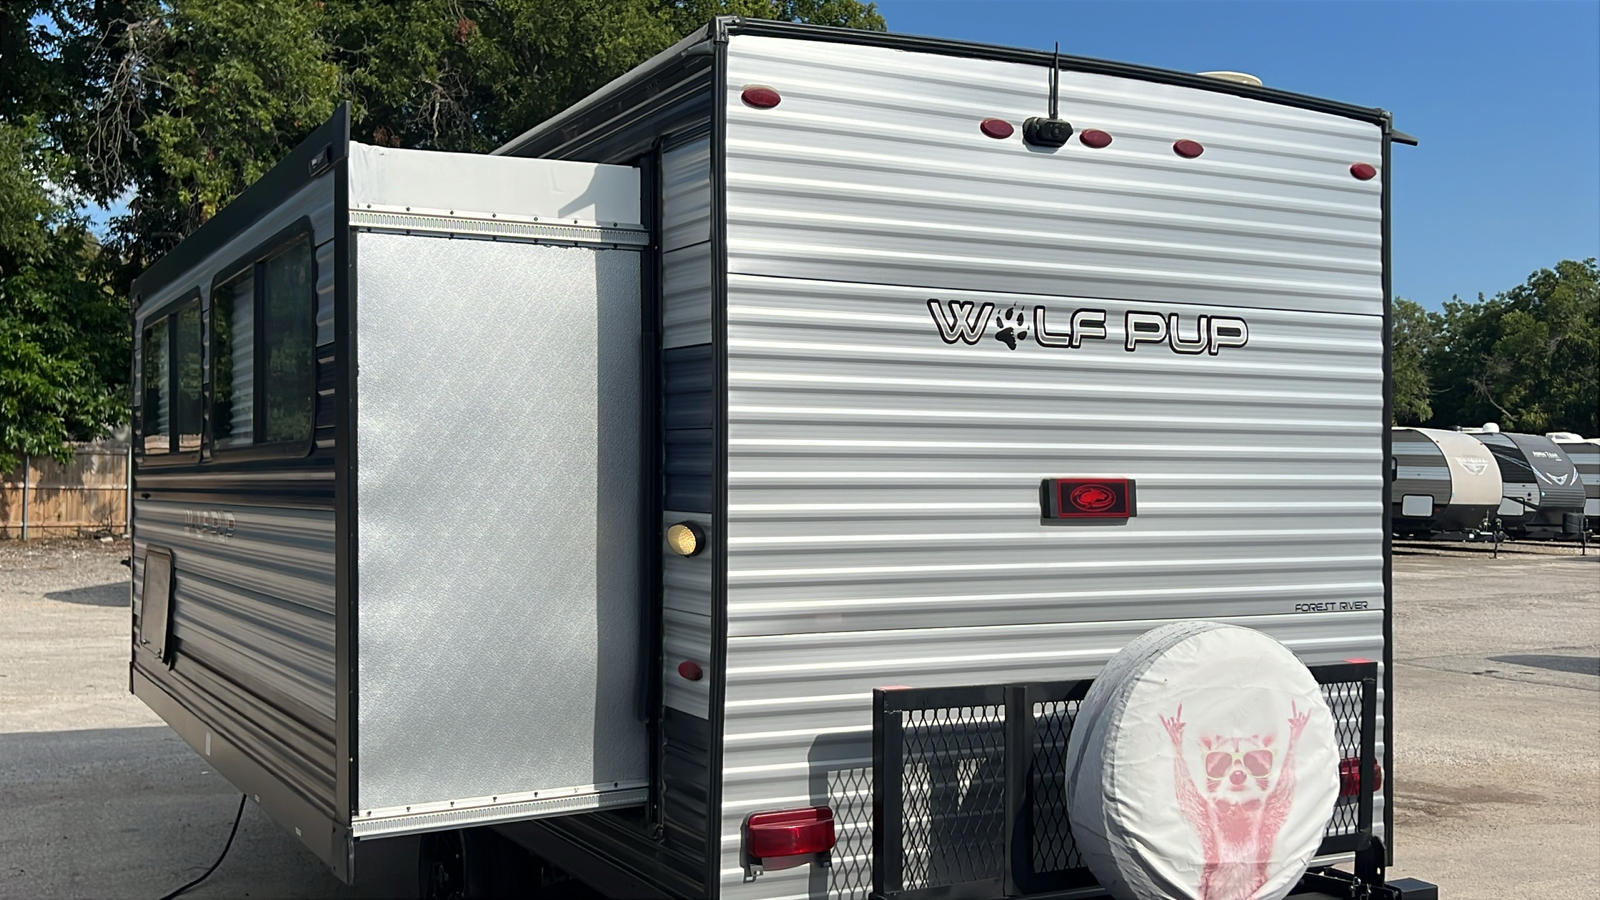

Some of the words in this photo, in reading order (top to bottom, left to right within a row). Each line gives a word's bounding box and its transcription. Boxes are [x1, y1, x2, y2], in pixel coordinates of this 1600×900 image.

[1125, 310, 1248, 355] PUP
[1295, 602, 1336, 612] FOREST
[1340, 601, 1368, 610] RIVER
